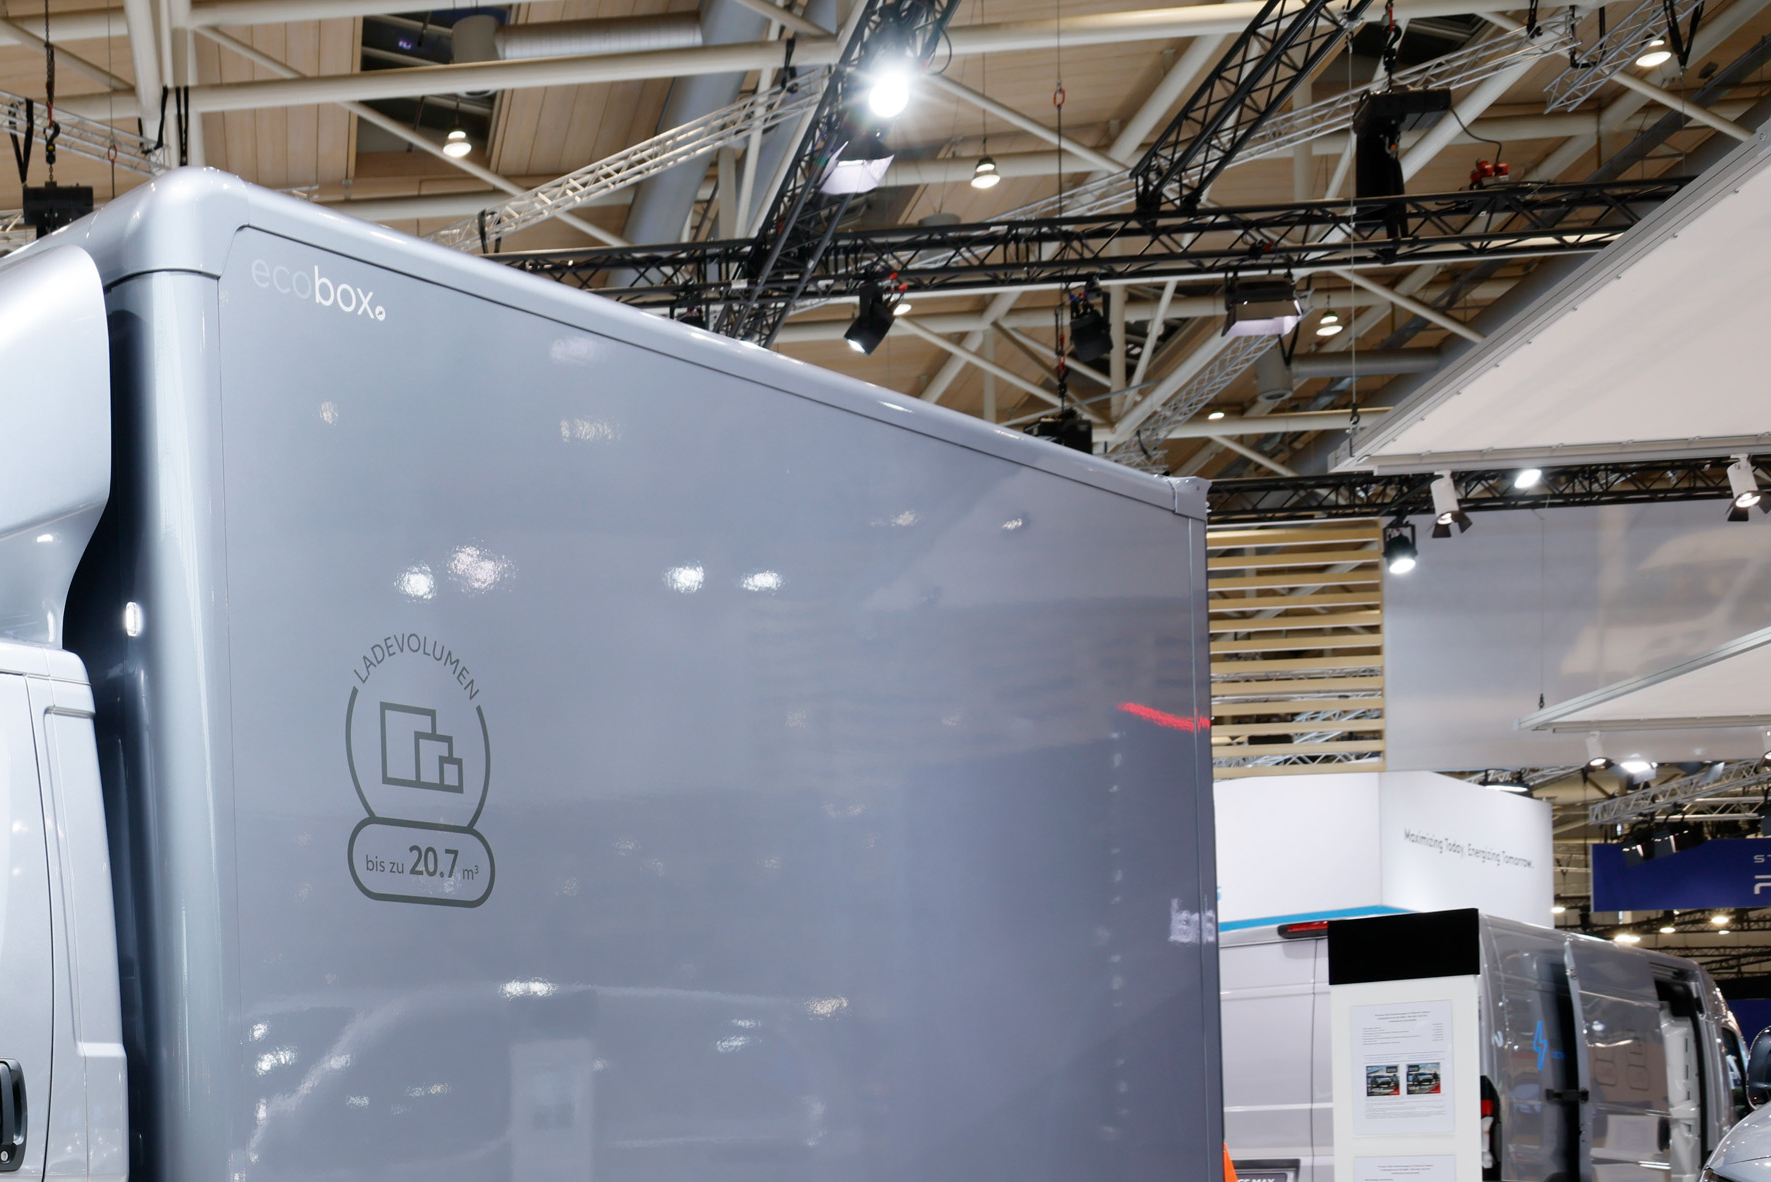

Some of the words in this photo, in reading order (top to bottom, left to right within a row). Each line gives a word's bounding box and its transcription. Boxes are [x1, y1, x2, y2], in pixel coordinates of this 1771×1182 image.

[353, 633, 480, 701] LADEVOLUMEN
[366, 855, 385, 873] bis
[389, 861, 405, 874] zu
[409, 845, 459, 879] 20.7
[1404, 827, 1443, 854] Maximizing
[1467, 843, 1500, 866] Energizing
